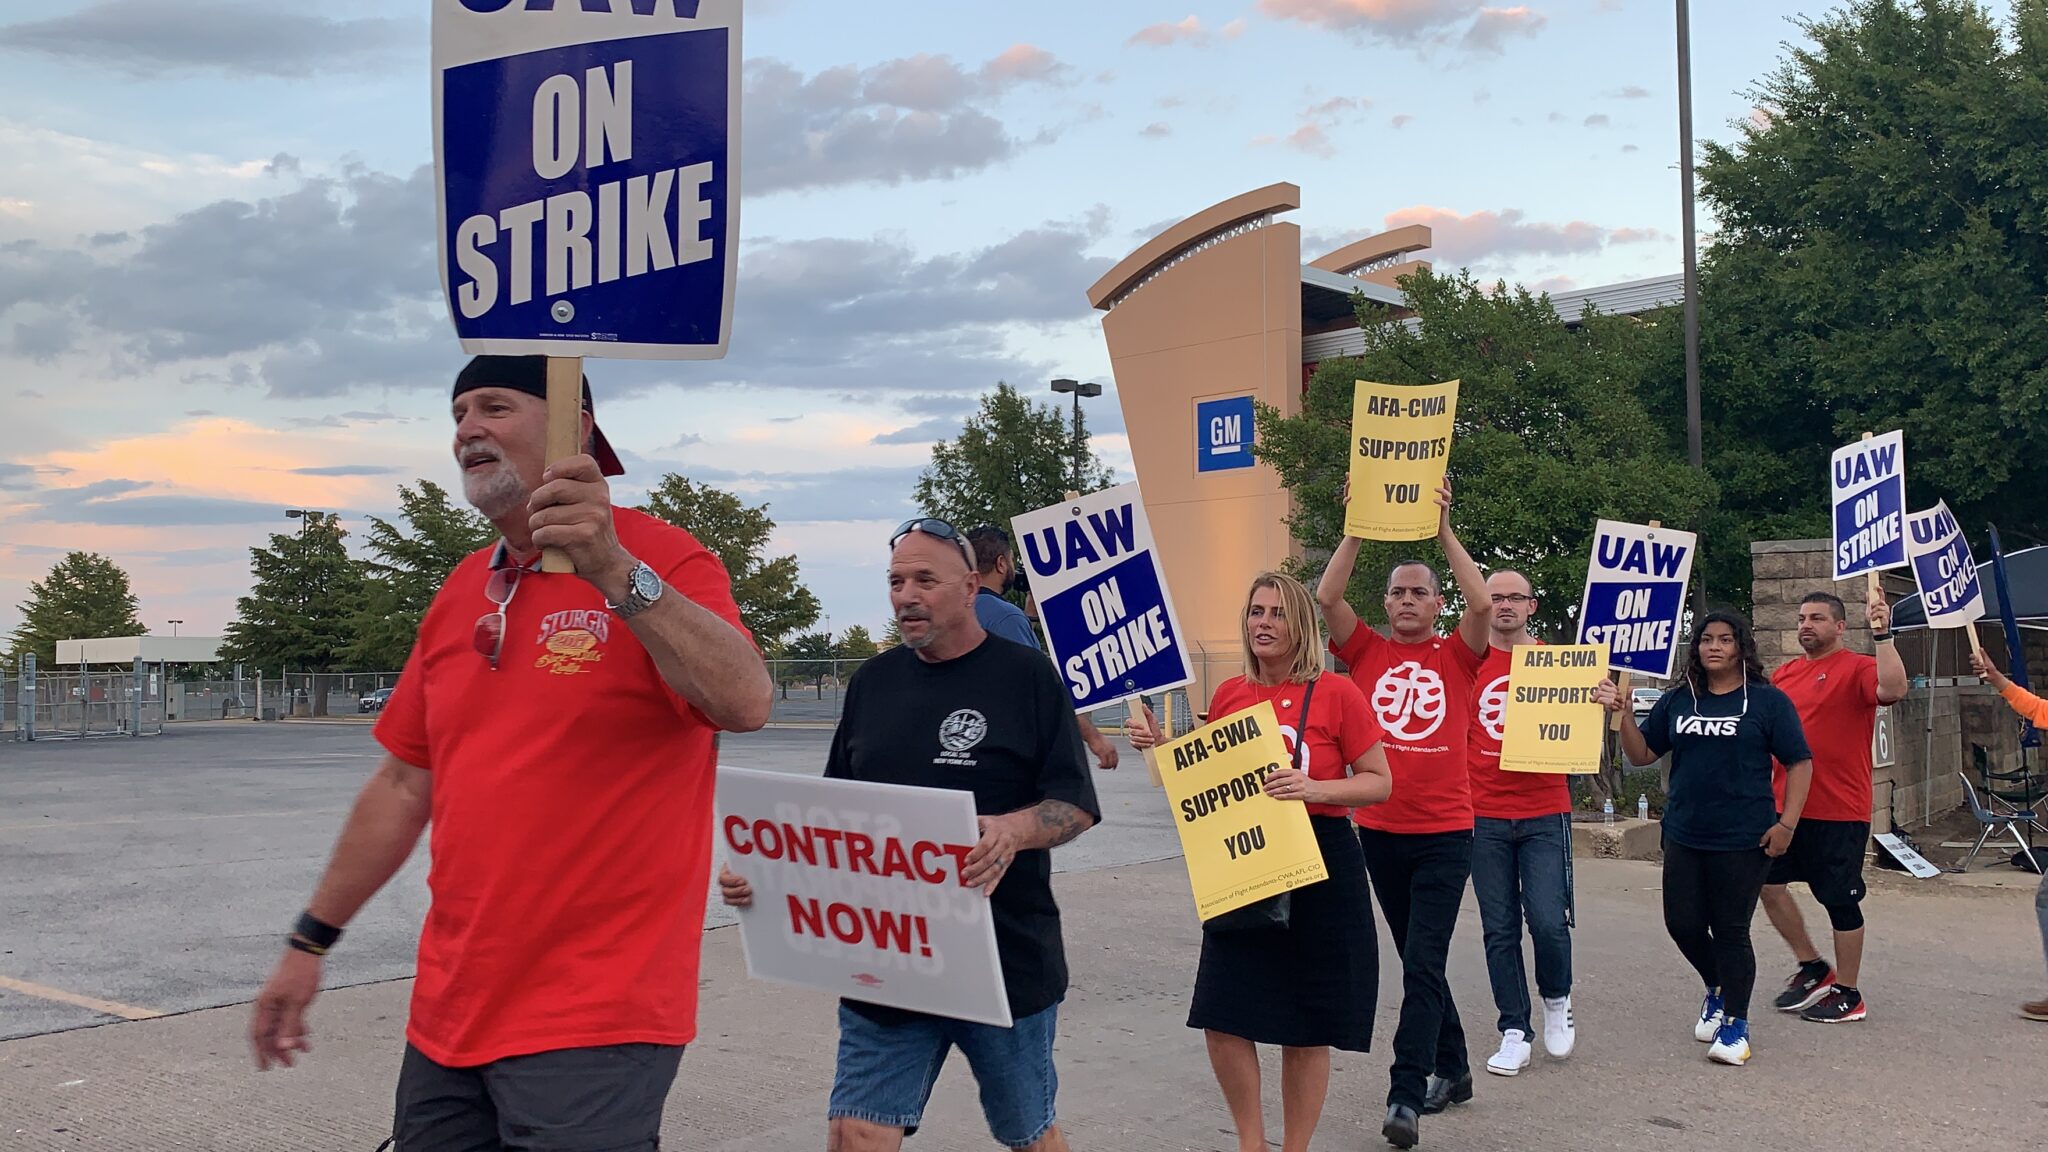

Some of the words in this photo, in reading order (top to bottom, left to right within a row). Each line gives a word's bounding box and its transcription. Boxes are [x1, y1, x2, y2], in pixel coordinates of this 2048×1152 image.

[533, 60, 632, 180] ON
[456, 161, 713, 319] STRIKE
[1367, 396, 1446, 418] AFA-CWA
[1210, 414, 1240, 446] GM
[1359, 437, 1446, 460] SUPPORTS
[1835, 443, 1896, 488] UAW
[1384, 484, 1420, 504] YOU
[1854, 490, 1878, 528] ON
[1023, 503, 1135, 577] UAW
[1598, 534, 1687, 578] UAW
[1839, 511, 1900, 570] STRIKE
[1938, 544, 1960, 578] ON
[1615, 588, 1652, 620] ON
[1925, 555, 1976, 614] STRIKE
[1081, 576, 1126, 635] ON
[536, 610, 610, 645] STURGIS
[1066, 605, 1171, 700] STRIKE
[1524, 651, 1596, 668] AFA-CWA
[1173, 716, 1262, 772] AFA-CWA
[1539, 724, 1570, 740] YOU
[1676, 716, 1740, 736] VANS
[1879, 720, 1888, 760] 6
[724, 815, 977, 888] CONTRACT
[1224, 825, 1266, 860] YOU
[787, 894, 933, 958] NOW!
